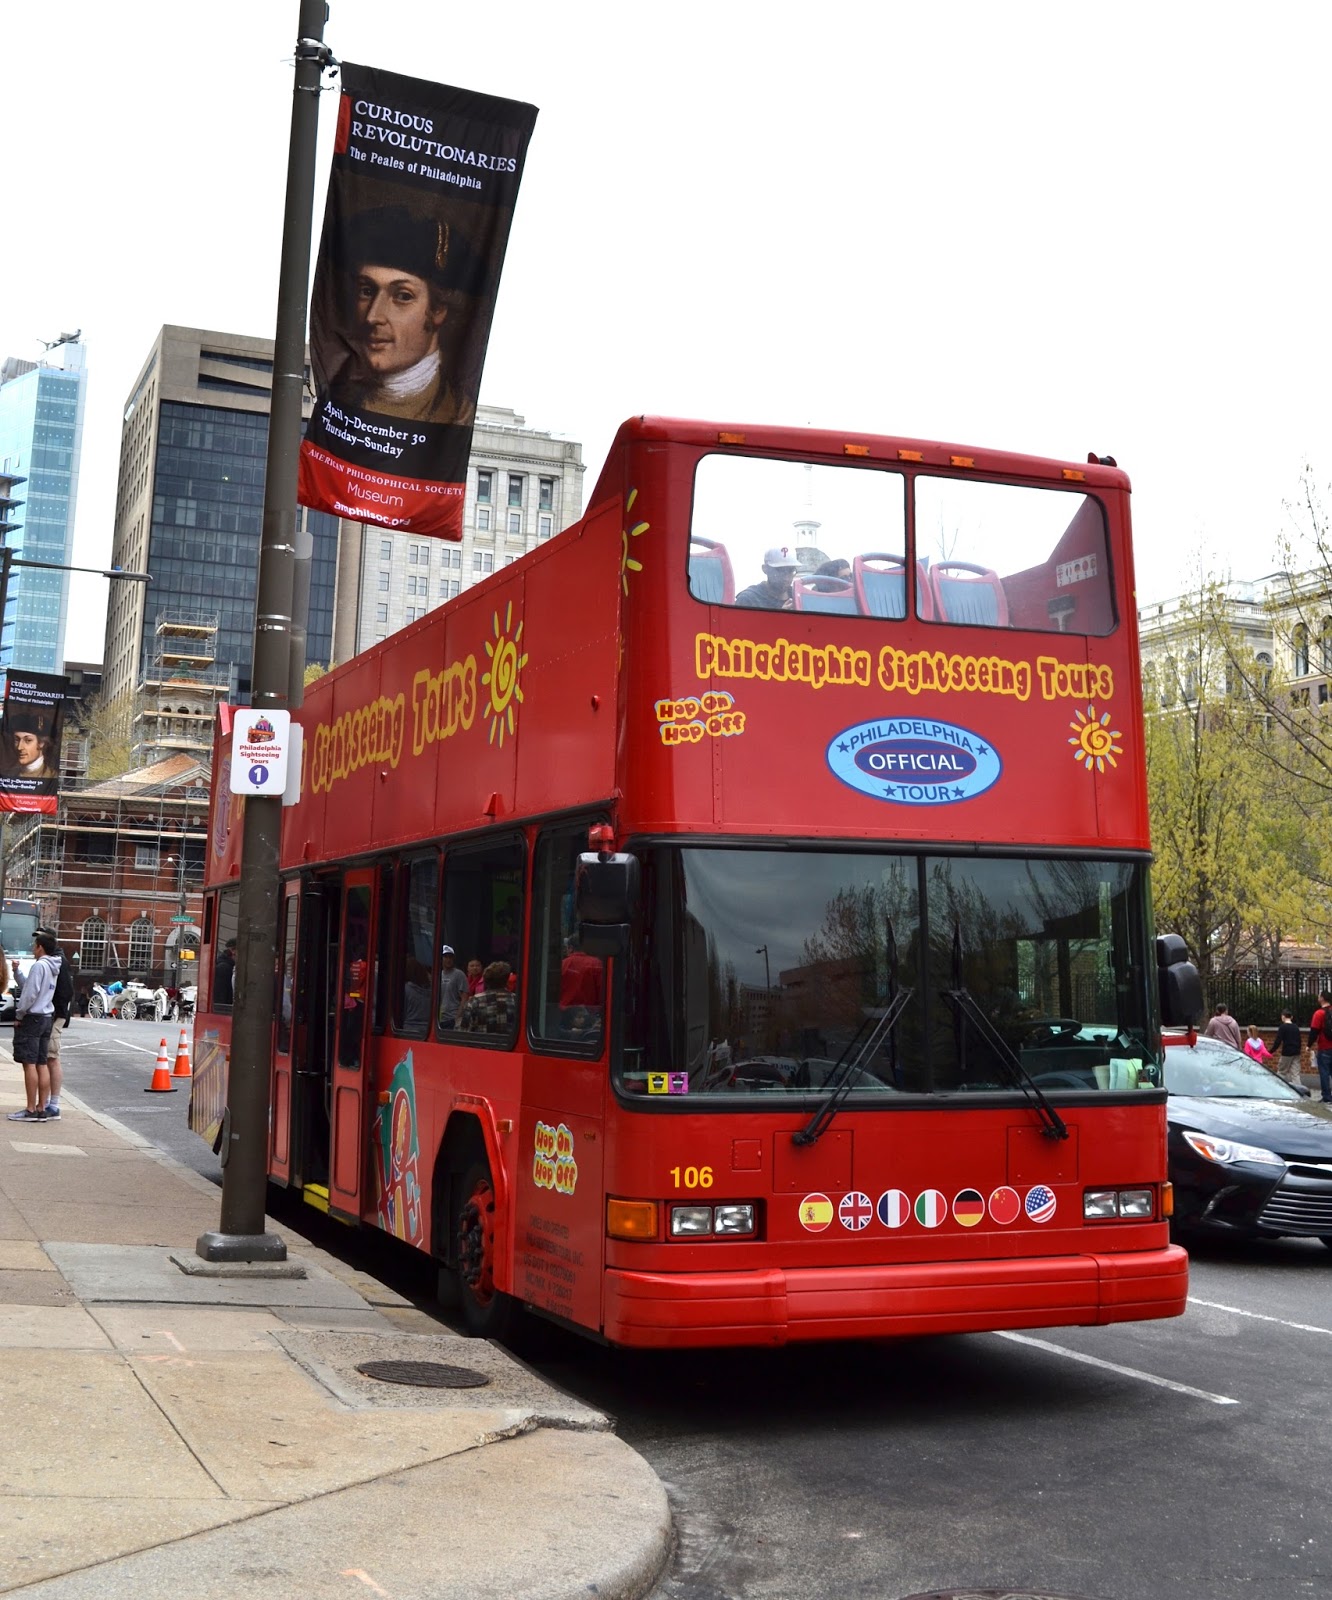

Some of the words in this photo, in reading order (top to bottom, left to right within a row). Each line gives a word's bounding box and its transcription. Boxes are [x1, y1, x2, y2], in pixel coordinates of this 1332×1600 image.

[354, 100, 434, 134] CURIOUS
[352, 121, 517, 173] REVOLUTIONARIES
[350, 146, 366, 161] The
[370, 154, 404, 170] Peales
[407, 161, 418, 174] of
[419, 165, 482, 190] Philadelphia
[324, 401, 343, 420] April
[411, 434, 426, 445] 30
[346, 467, 421, 492] PHILOSOPHICAL
[425, 485, 463, 496] SOCIETY
[347, 481, 403, 507] Museum
[695, 632, 872, 689] Philadelphia
[877, 645, 1031, 701] Sightseeing
[1036, 655, 1114, 701] Tours
[10, 681, 37, 689] CURIOUS
[413, 654, 477, 757] Tours
[656, 699, 700, 722] Hop
[701, 692, 732, 713] On
[661, 723, 705, 745] Hop
[705, 711, 746, 737] Off
[849, 721, 974, 753] PHILADELPHIA
[254, 767, 262, 782] 1
[868, 753, 964, 771] OFFICIAL
[896, 785, 951, 800] TOUR
[535, 1124, 556, 1157] Hop
[557, 1127, 573, 1157] On
[534, 1157, 556, 1188] Hop
[556, 1161, 577, 1193] Off
[670, 1166, 714, 1188] 106
